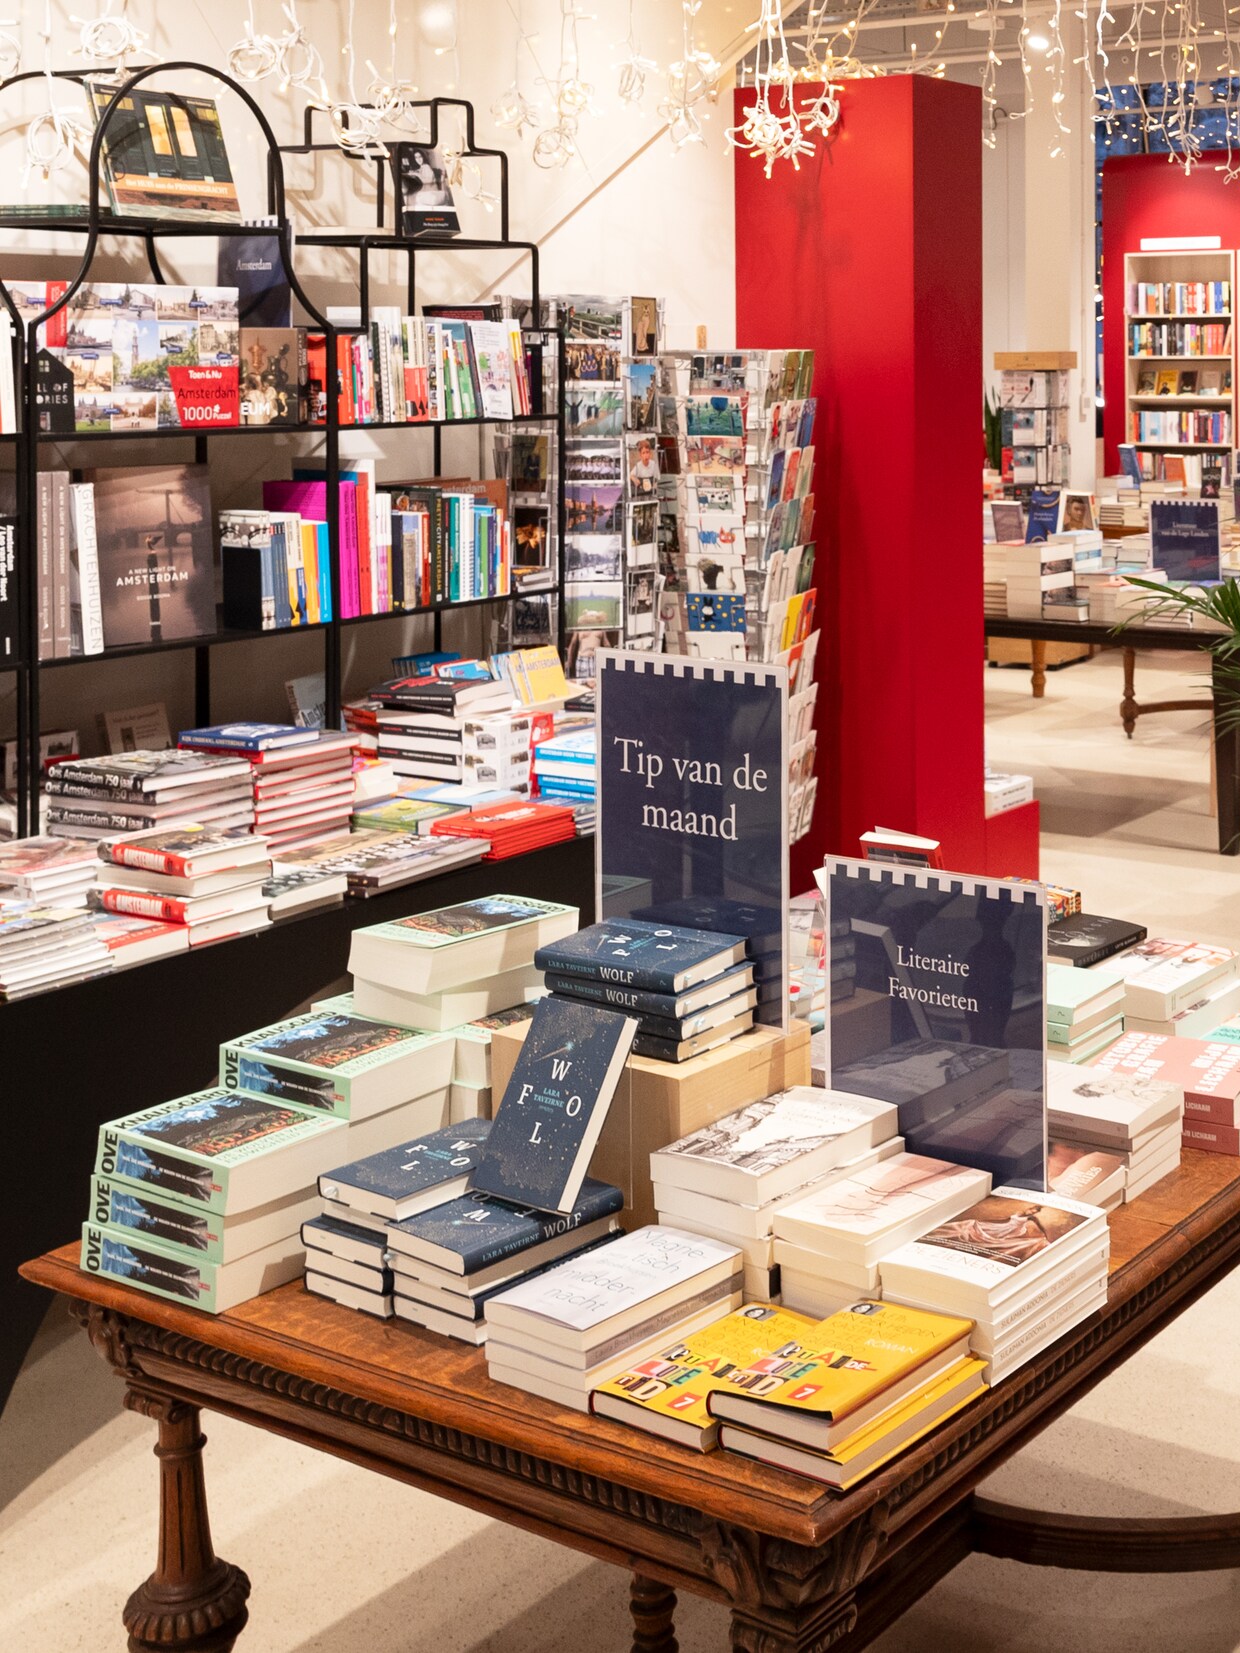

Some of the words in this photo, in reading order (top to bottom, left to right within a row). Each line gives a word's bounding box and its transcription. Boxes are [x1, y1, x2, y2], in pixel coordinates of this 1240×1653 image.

[236, 258, 272, 271] Amsterdam
[177, 387, 236, 400] Amsterdam
[182, 406, 213, 421] 1000
[240, 402, 271, 416] EUM
[442, 484, 486, 493] sterdam
[82, 488, 103, 649] GRACHTENHUIZEN
[116, 571, 189, 587] AMSTERDAM
[134, 568, 149, 576] NEW
[149, 566, 166, 575] LIGHT
[613, 736, 664, 789] Tip
[672, 757, 723, 786] van
[733, 753, 768, 792] de
[49, 766, 62, 778] Ons
[63, 769, 103, 785] Amsterdam
[105, 772, 119, 786] 750
[120, 776, 134, 788] jaar
[45, 781, 60, 793] Ons
[63, 783, 106, 799] Amsterdam
[63, 811, 108, 827] Amsterdam
[111, 816, 127, 829] 750
[128, 819, 144, 830] jaar
[641, 803, 739, 841] maand
[548, 959, 564, 970] LARA
[565, 962, 596, 975] TAVEIRNE
[600, 966, 634, 984] WOLF
[896, 945, 970, 977] Literaire
[557, 981, 573, 990] LARA
[606, 989, 638, 1007] WOLF
[888, 976, 979, 1013] Favorieten
[1121, 1035, 1169, 1069] GRAFIE
[1191, 1043, 1228, 1069] MIJN
[225, 1050, 238, 1089] OVE
[551, 1058, 573, 1082] W
[517, 1083, 533, 1105] F
[533, 1094, 565, 1108] TAVEIRNE
[543, 1087, 561, 1098] LARA
[566, 1095, 582, 1117] O
[1185, 1101, 1211, 1112] LICHAAM
[529, 1121, 542, 1144] L
[1190, 1131, 1217, 1142] LICHAAM
[101, 1132, 118, 1174] OVE
[405, 1144, 428, 1155] F
[450, 1140, 477, 1151] W
[400, 1160, 421, 1171] L
[450, 1157, 470, 1167] O
[95, 1182, 111, 1224] OVE
[482, 1249, 503, 1262] LARA
[504, 1233, 540, 1251] TAVEIRNE
[544, 1212, 582, 1239] WOLF
[86, 1230, 102, 1271] OVE
[632, 1252, 680, 1273] tisch
[544, 1285, 608, 1312] nacht
[864, 1338, 917, 1354] ROMAN
[674, 1396, 695, 1409] 7
[795, 1388, 816, 1399] 7
